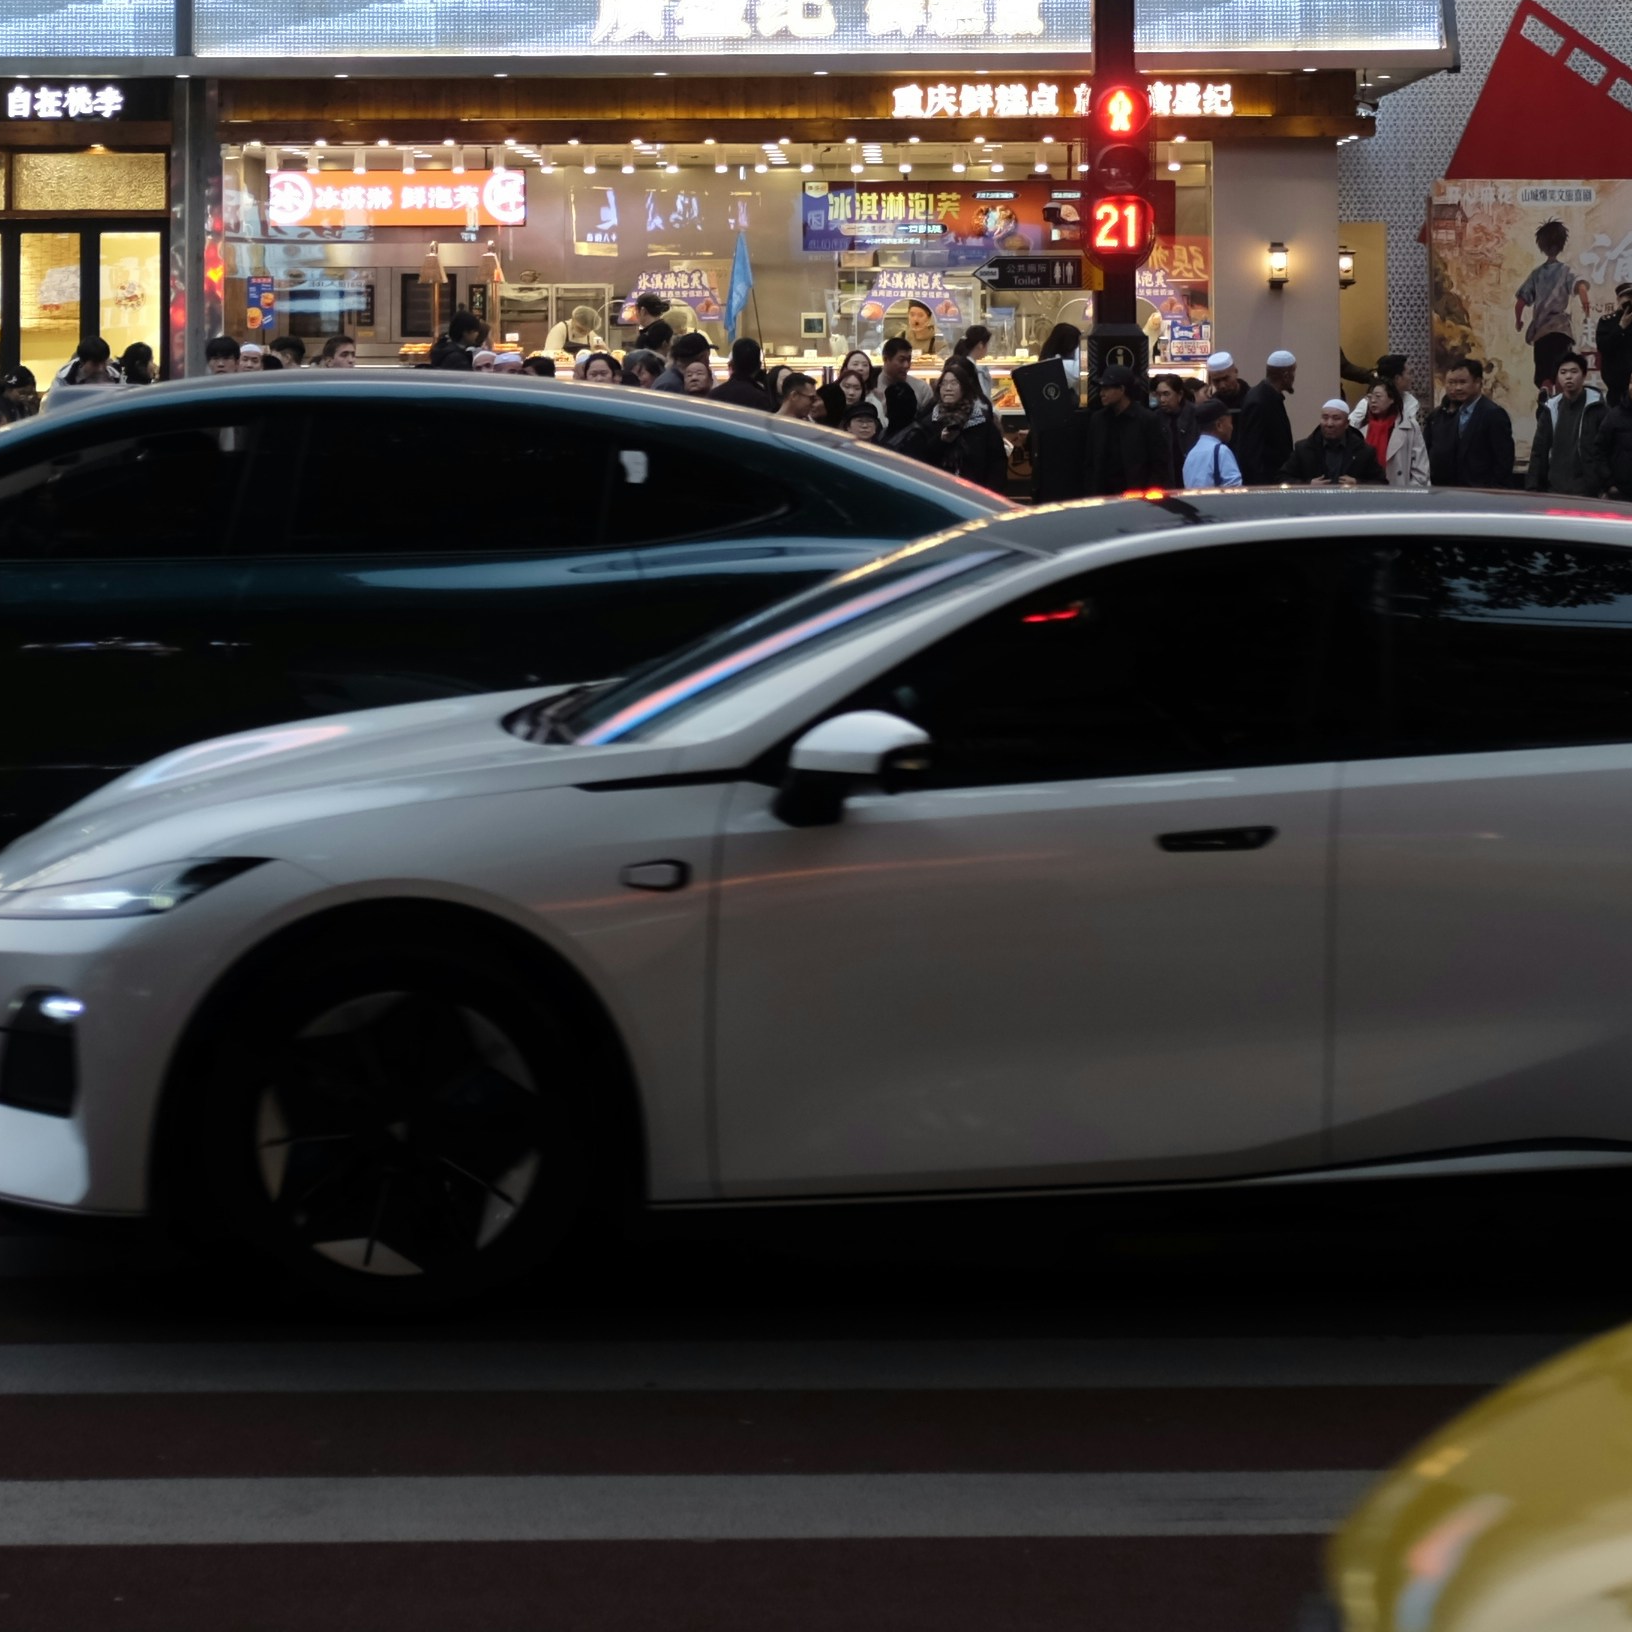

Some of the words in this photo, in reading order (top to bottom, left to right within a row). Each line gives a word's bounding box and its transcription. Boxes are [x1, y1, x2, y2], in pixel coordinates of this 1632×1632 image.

[891, 82, 1060, 118] 重庆鲜糕点
[828, 191, 962, 221] 冰淇淋泡芙
[1094, 204, 1137, 248] 21
[1012, 275, 1041, 286] Toilet
